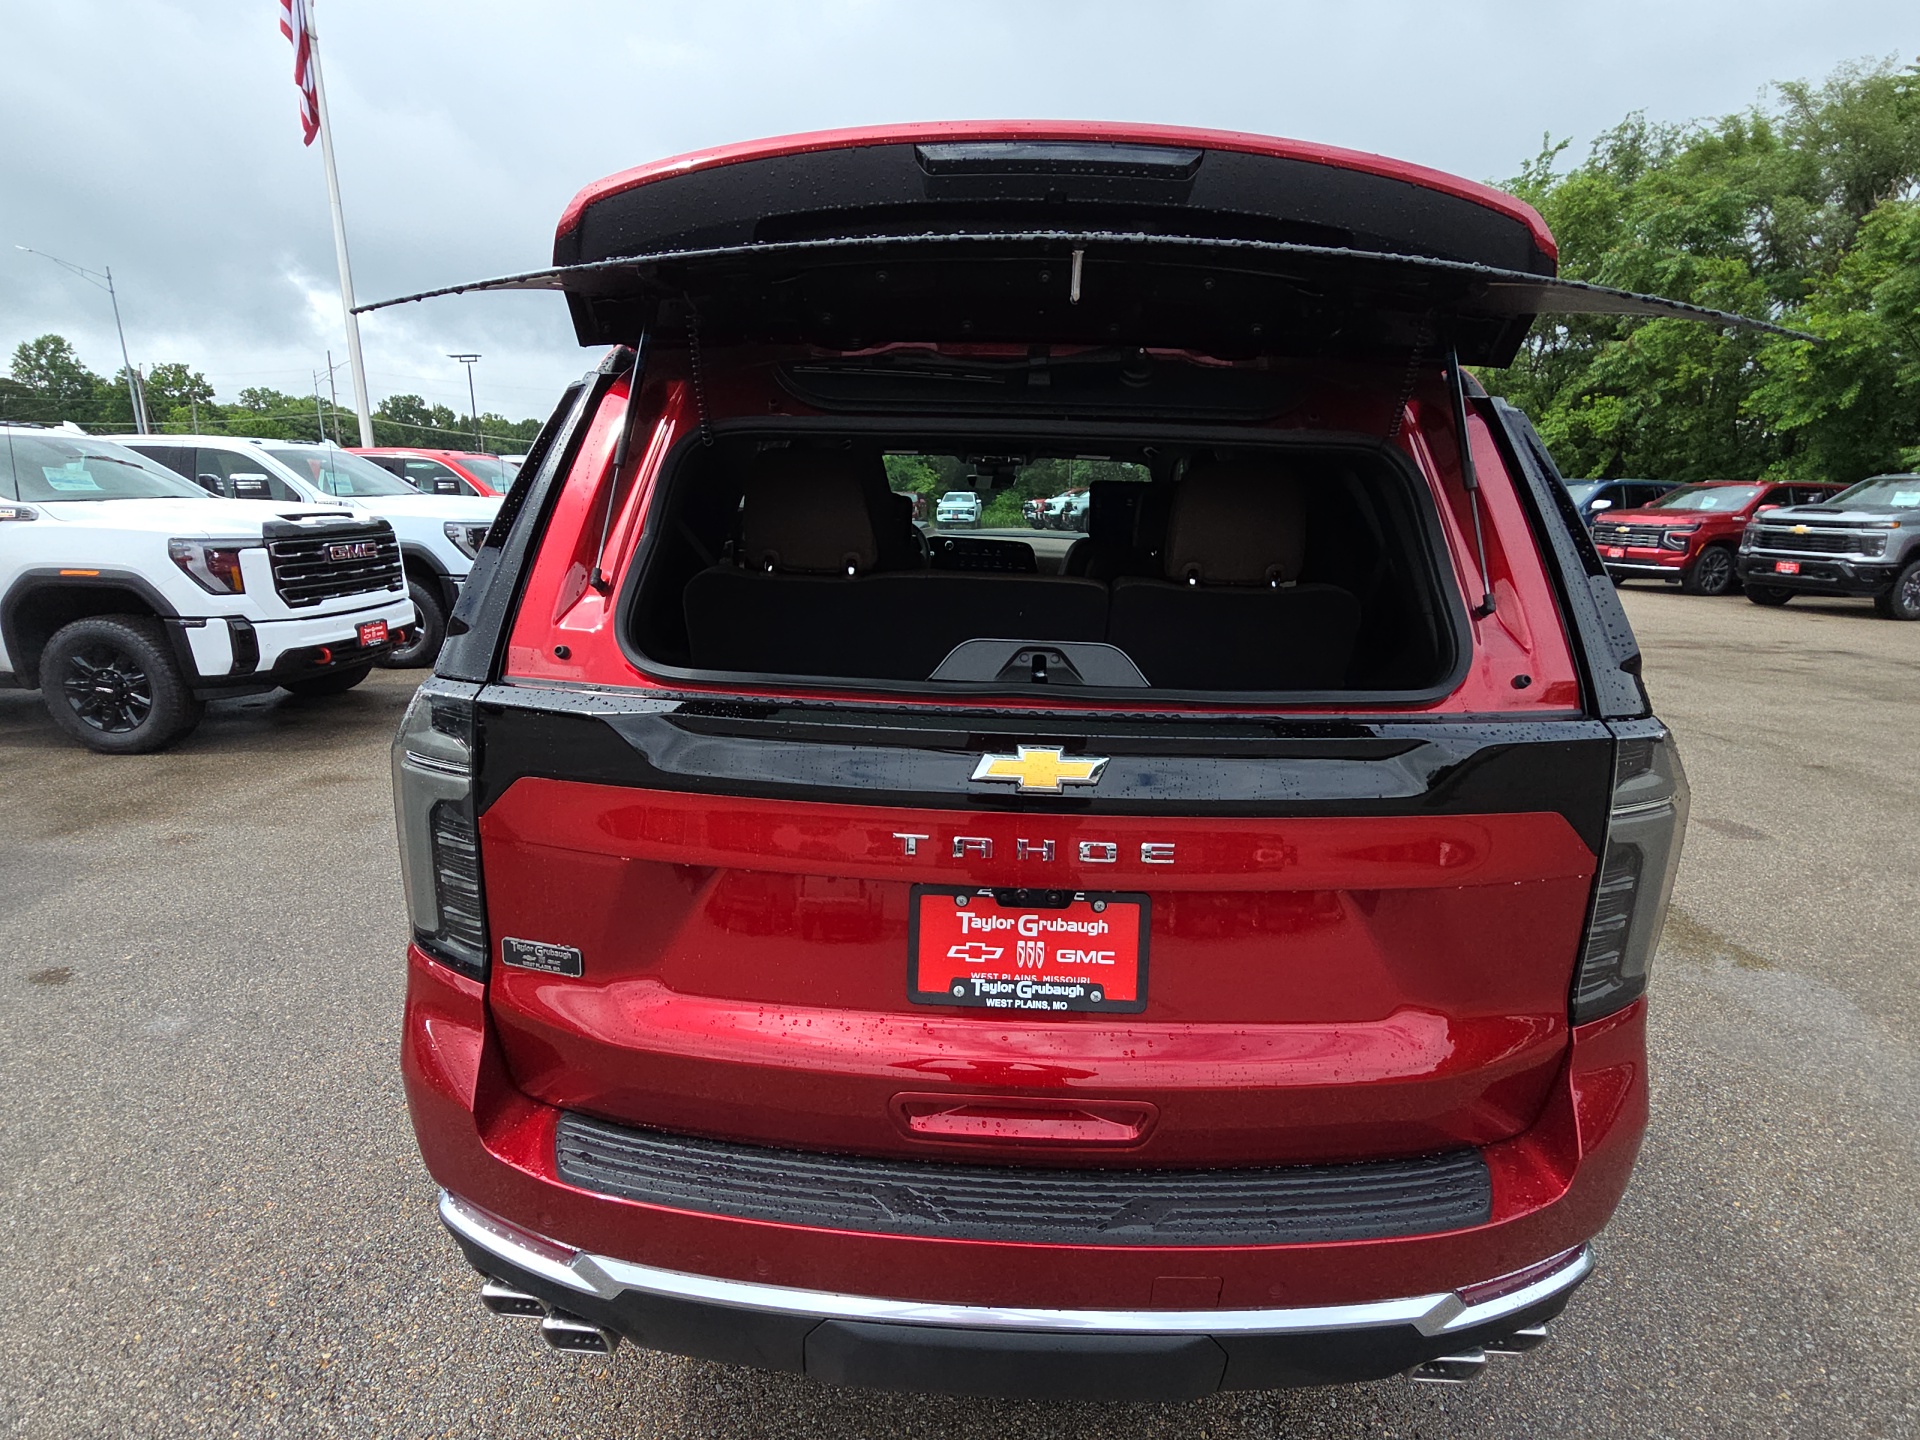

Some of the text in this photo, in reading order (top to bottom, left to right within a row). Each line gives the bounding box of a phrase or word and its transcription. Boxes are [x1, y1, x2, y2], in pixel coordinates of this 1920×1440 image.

[330, 543, 377, 560] GMC
[892, 832, 1176, 863] TAHOE
[956, 911, 1109, 937] Taylor Grubaugh
[535, 946, 571, 959] Grubaugh
[1056, 949, 1116, 965] GMC
[970, 979, 1085, 998] Taylor Grubaugh
[986, 998, 1068, 1010] WEST PLAINS, MO
